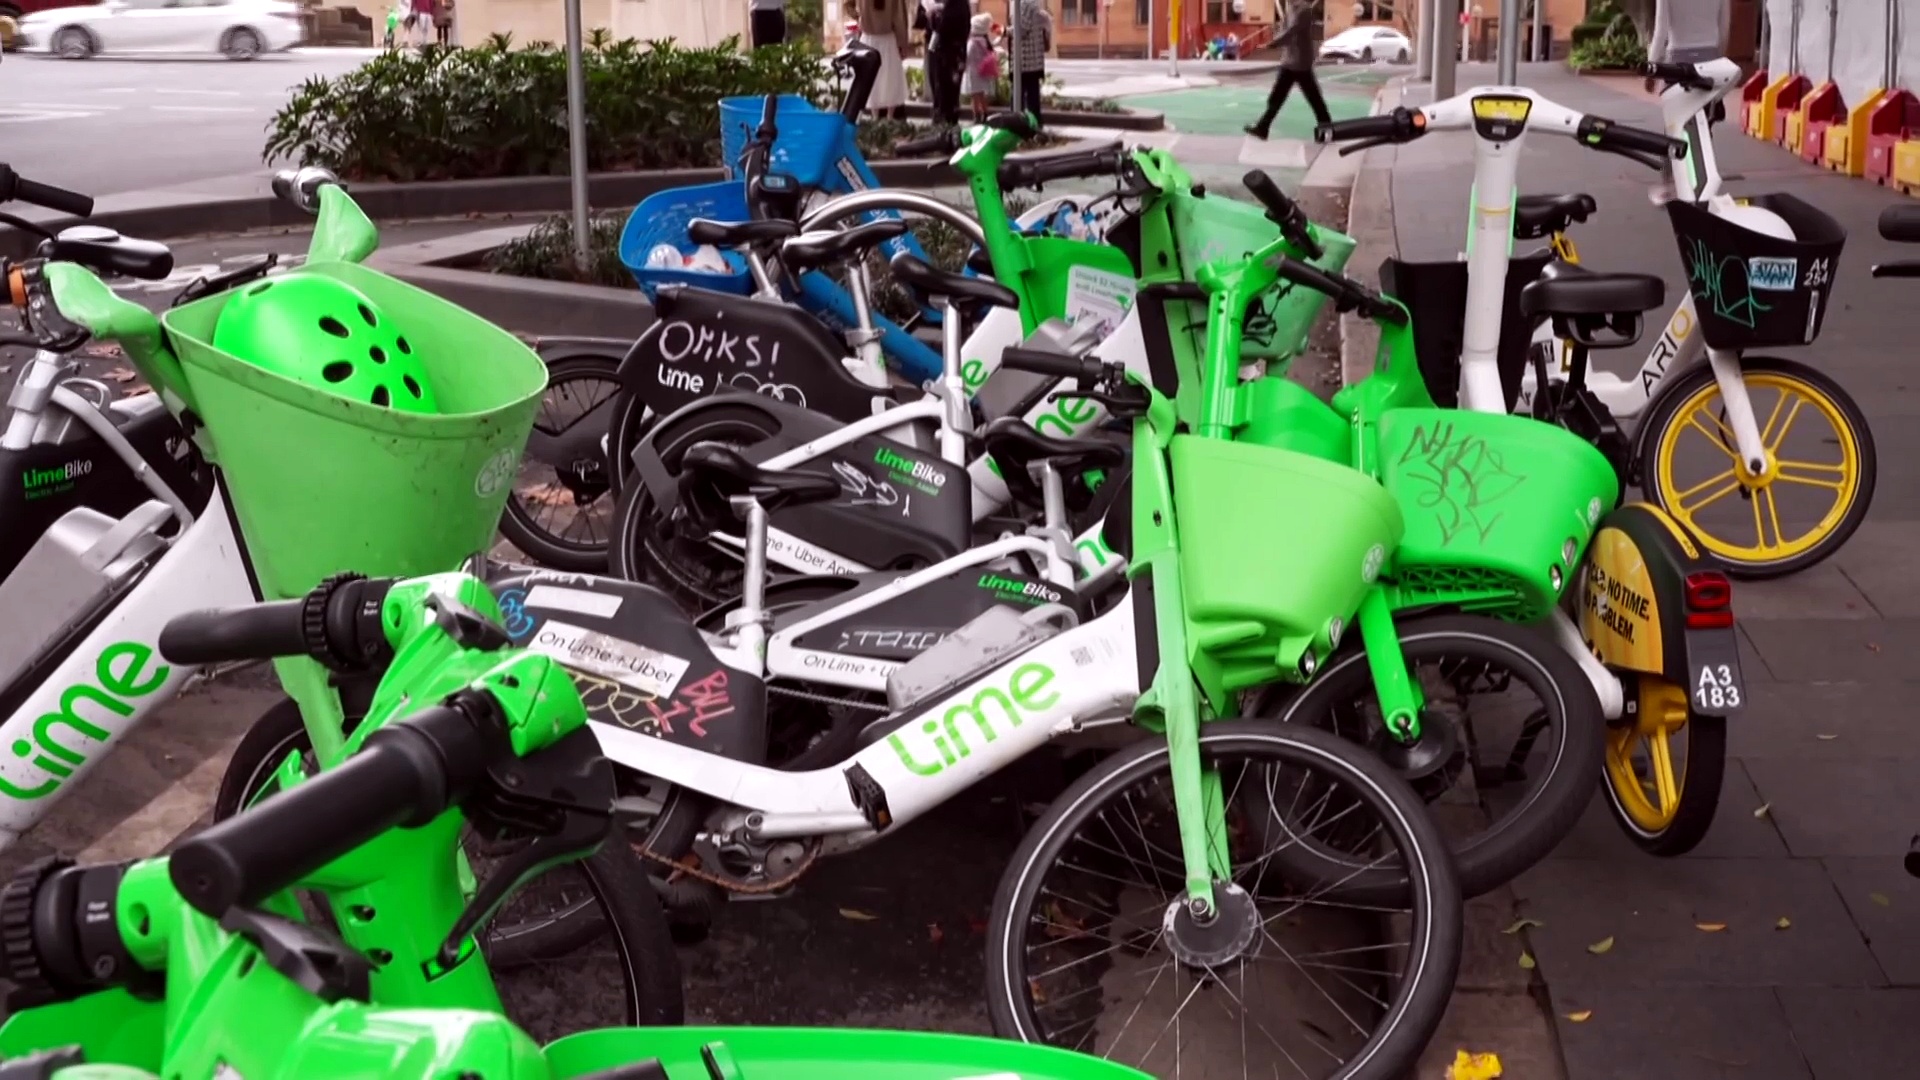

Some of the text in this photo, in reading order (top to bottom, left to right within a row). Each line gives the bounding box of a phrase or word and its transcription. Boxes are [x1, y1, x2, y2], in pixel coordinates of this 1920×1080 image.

[1803, 271, 1828, 287] 254
[1810, 257, 1829, 272] A4
[1642, 308, 1694, 397] ARIO
[657, 363, 704, 394] Lime
[23, 459, 93, 489] LimeBike
[875, 447, 946, 488] LimeBike
[795, 547, 826, 568] Uber
[978, 574, 1062, 603] LimeBike
[539, 631, 566, 650] On
[567, 634, 613, 663] Lime
[629, 656, 676, 683] Uber
[803, 655, 826, 668] On
[828, 658, 866, 675] Lime
[1699, 664, 1733, 689] A3
[1696, 685, 1741, 708] 183
[887, 661, 1062, 777] Lime
